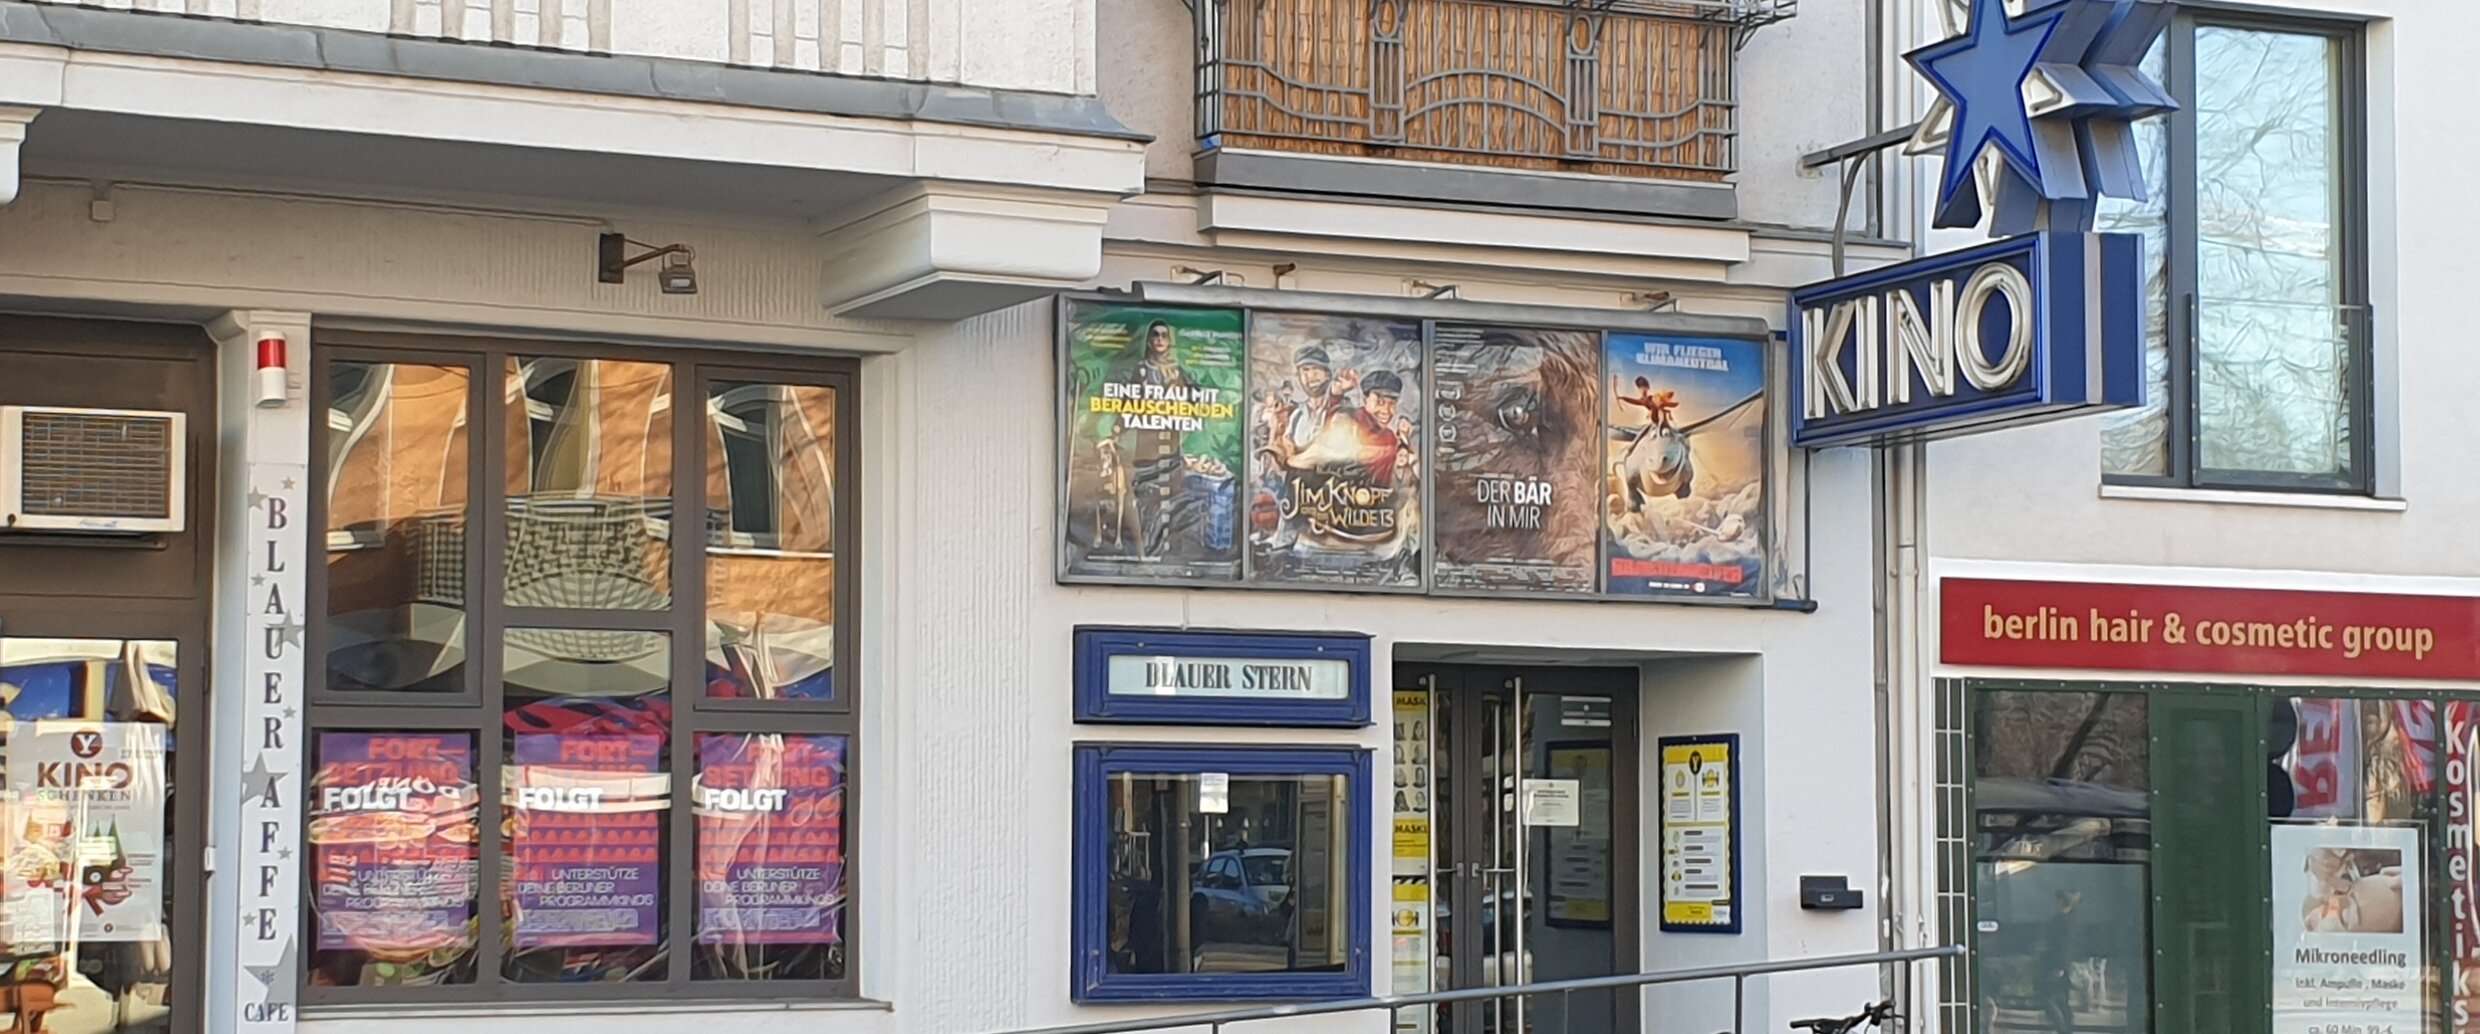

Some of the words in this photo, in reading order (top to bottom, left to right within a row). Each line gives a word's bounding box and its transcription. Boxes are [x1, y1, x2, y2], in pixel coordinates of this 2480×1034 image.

[1802, 262, 2032, 420] KINO
[1103, 383, 1141, 398] EINE
[1144, 385, 1187, 400] FRAU
[1192, 388, 1219, 403] MIT
[1090, 397, 1233, 418] BERAUSCHENDEN
[1121, 413, 1203, 431] TALENTEN
[1477, 480, 1511, 503] DER
[1514, 476, 1552, 505] BÄR
[1331, 508, 1378, 528] WILDE
[1487, 505, 1505, 528] IN
[1509, 506, 1540, 529] MIR
[263, 497, 288, 749] BLAUER
[1983, 605, 2078, 641] berlin
[2089, 608, 2153, 642] hair
[2162, 612, 2187, 644] &
[2195, 617, 2333, 649] cosmetic
[2342, 624, 2434, 661] group
[1145, 662, 1232, 689] BLAUER
[1242, 664, 1312, 691] STERN
[37, 762, 134, 788] KINO
[324, 787, 411, 811] FOLGT
[518, 787, 604, 810] FOLGT
[704, 788, 787, 811] FOLGT
[257, 775, 281, 940] AFFE
[2445, 720, 2471, 1034] Kosmetiks
[2295, 949, 2407, 968] Mikroneedling
